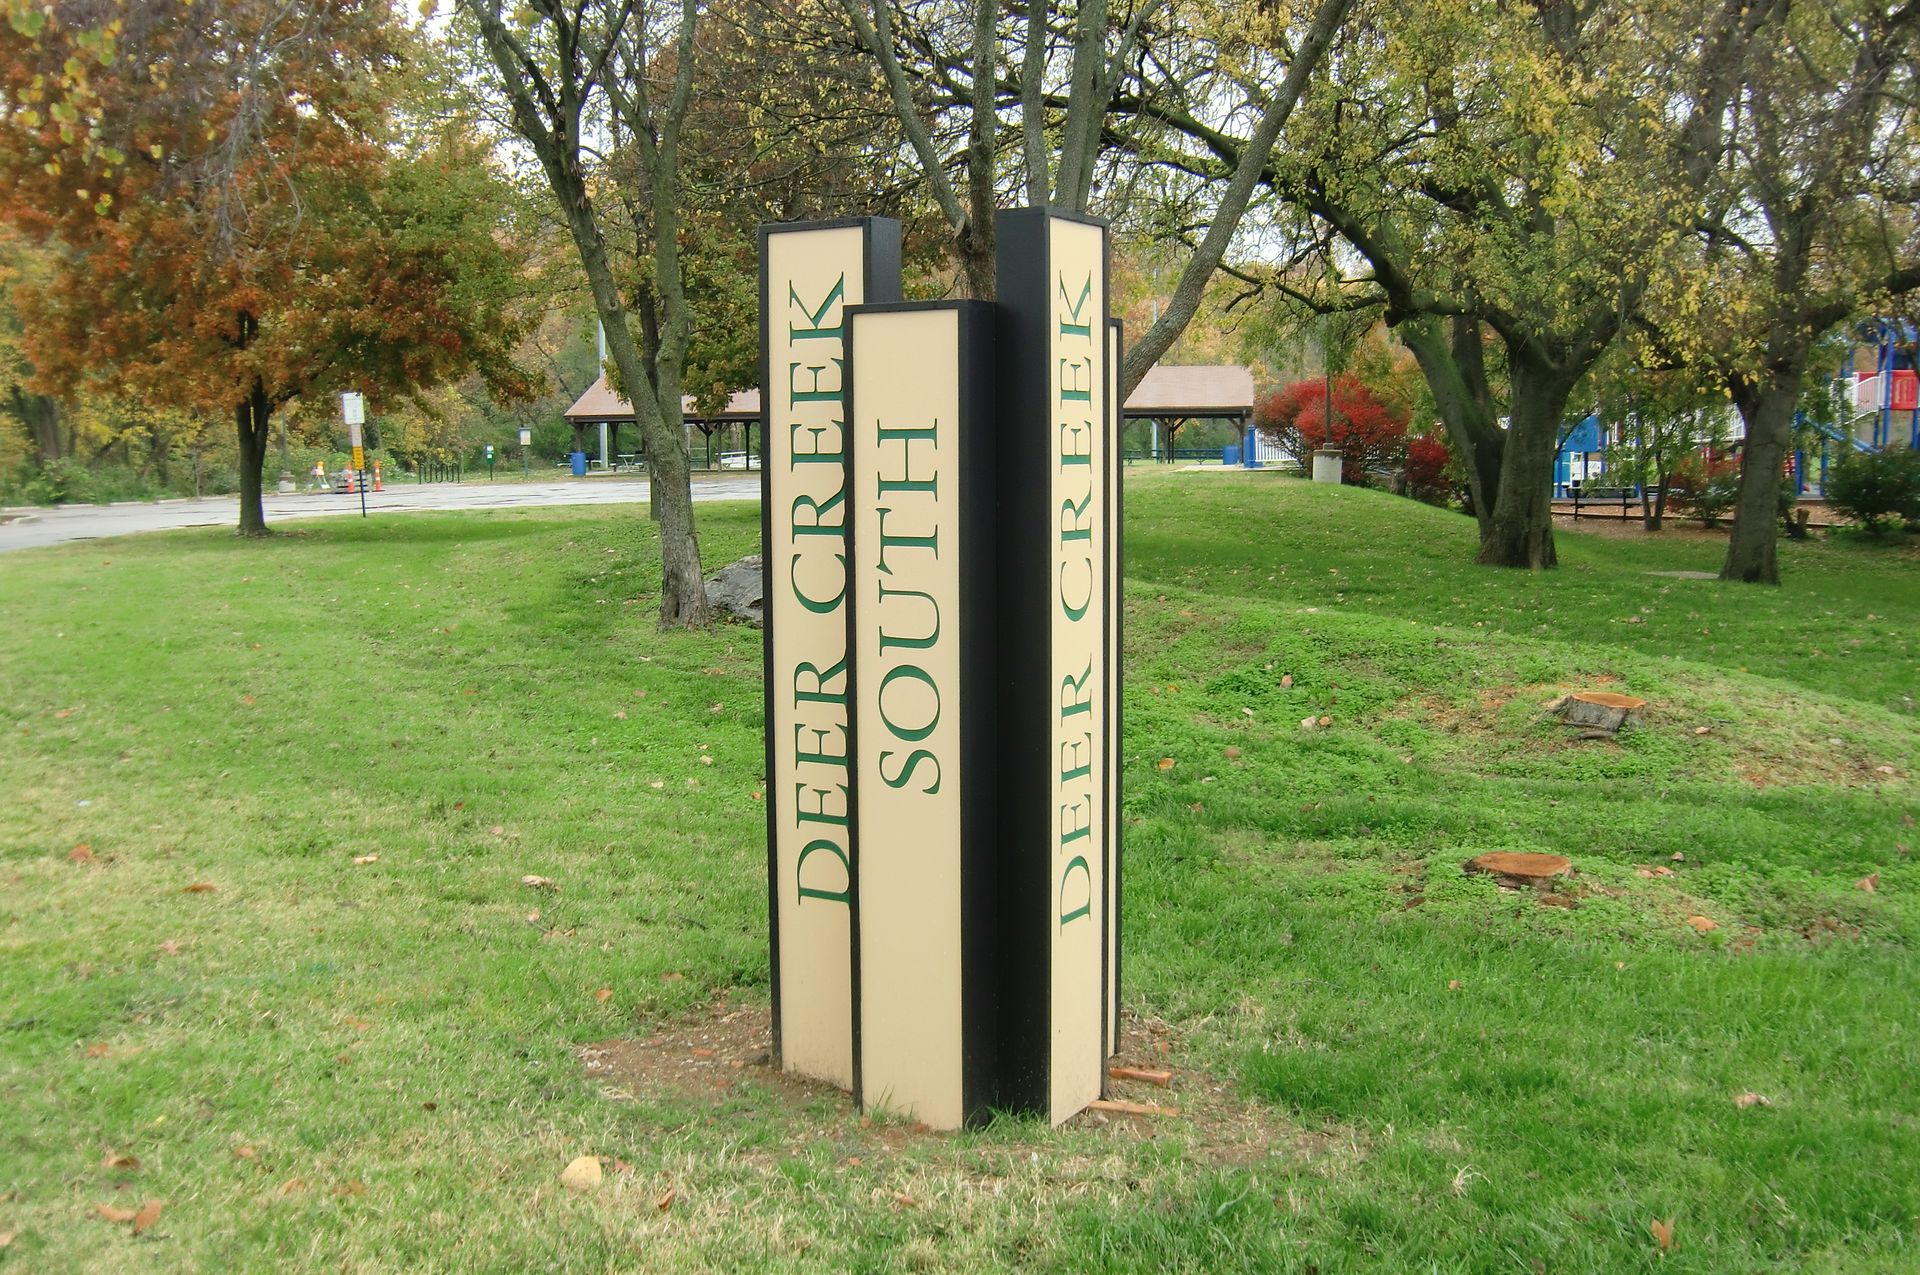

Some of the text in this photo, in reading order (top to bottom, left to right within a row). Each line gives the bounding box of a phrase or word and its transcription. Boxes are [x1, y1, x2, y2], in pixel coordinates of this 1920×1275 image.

[789, 271, 851, 911] DEER CREEK
[875, 417, 941, 795] SOUTH
[1059, 269, 1093, 937] DEER CREEK
